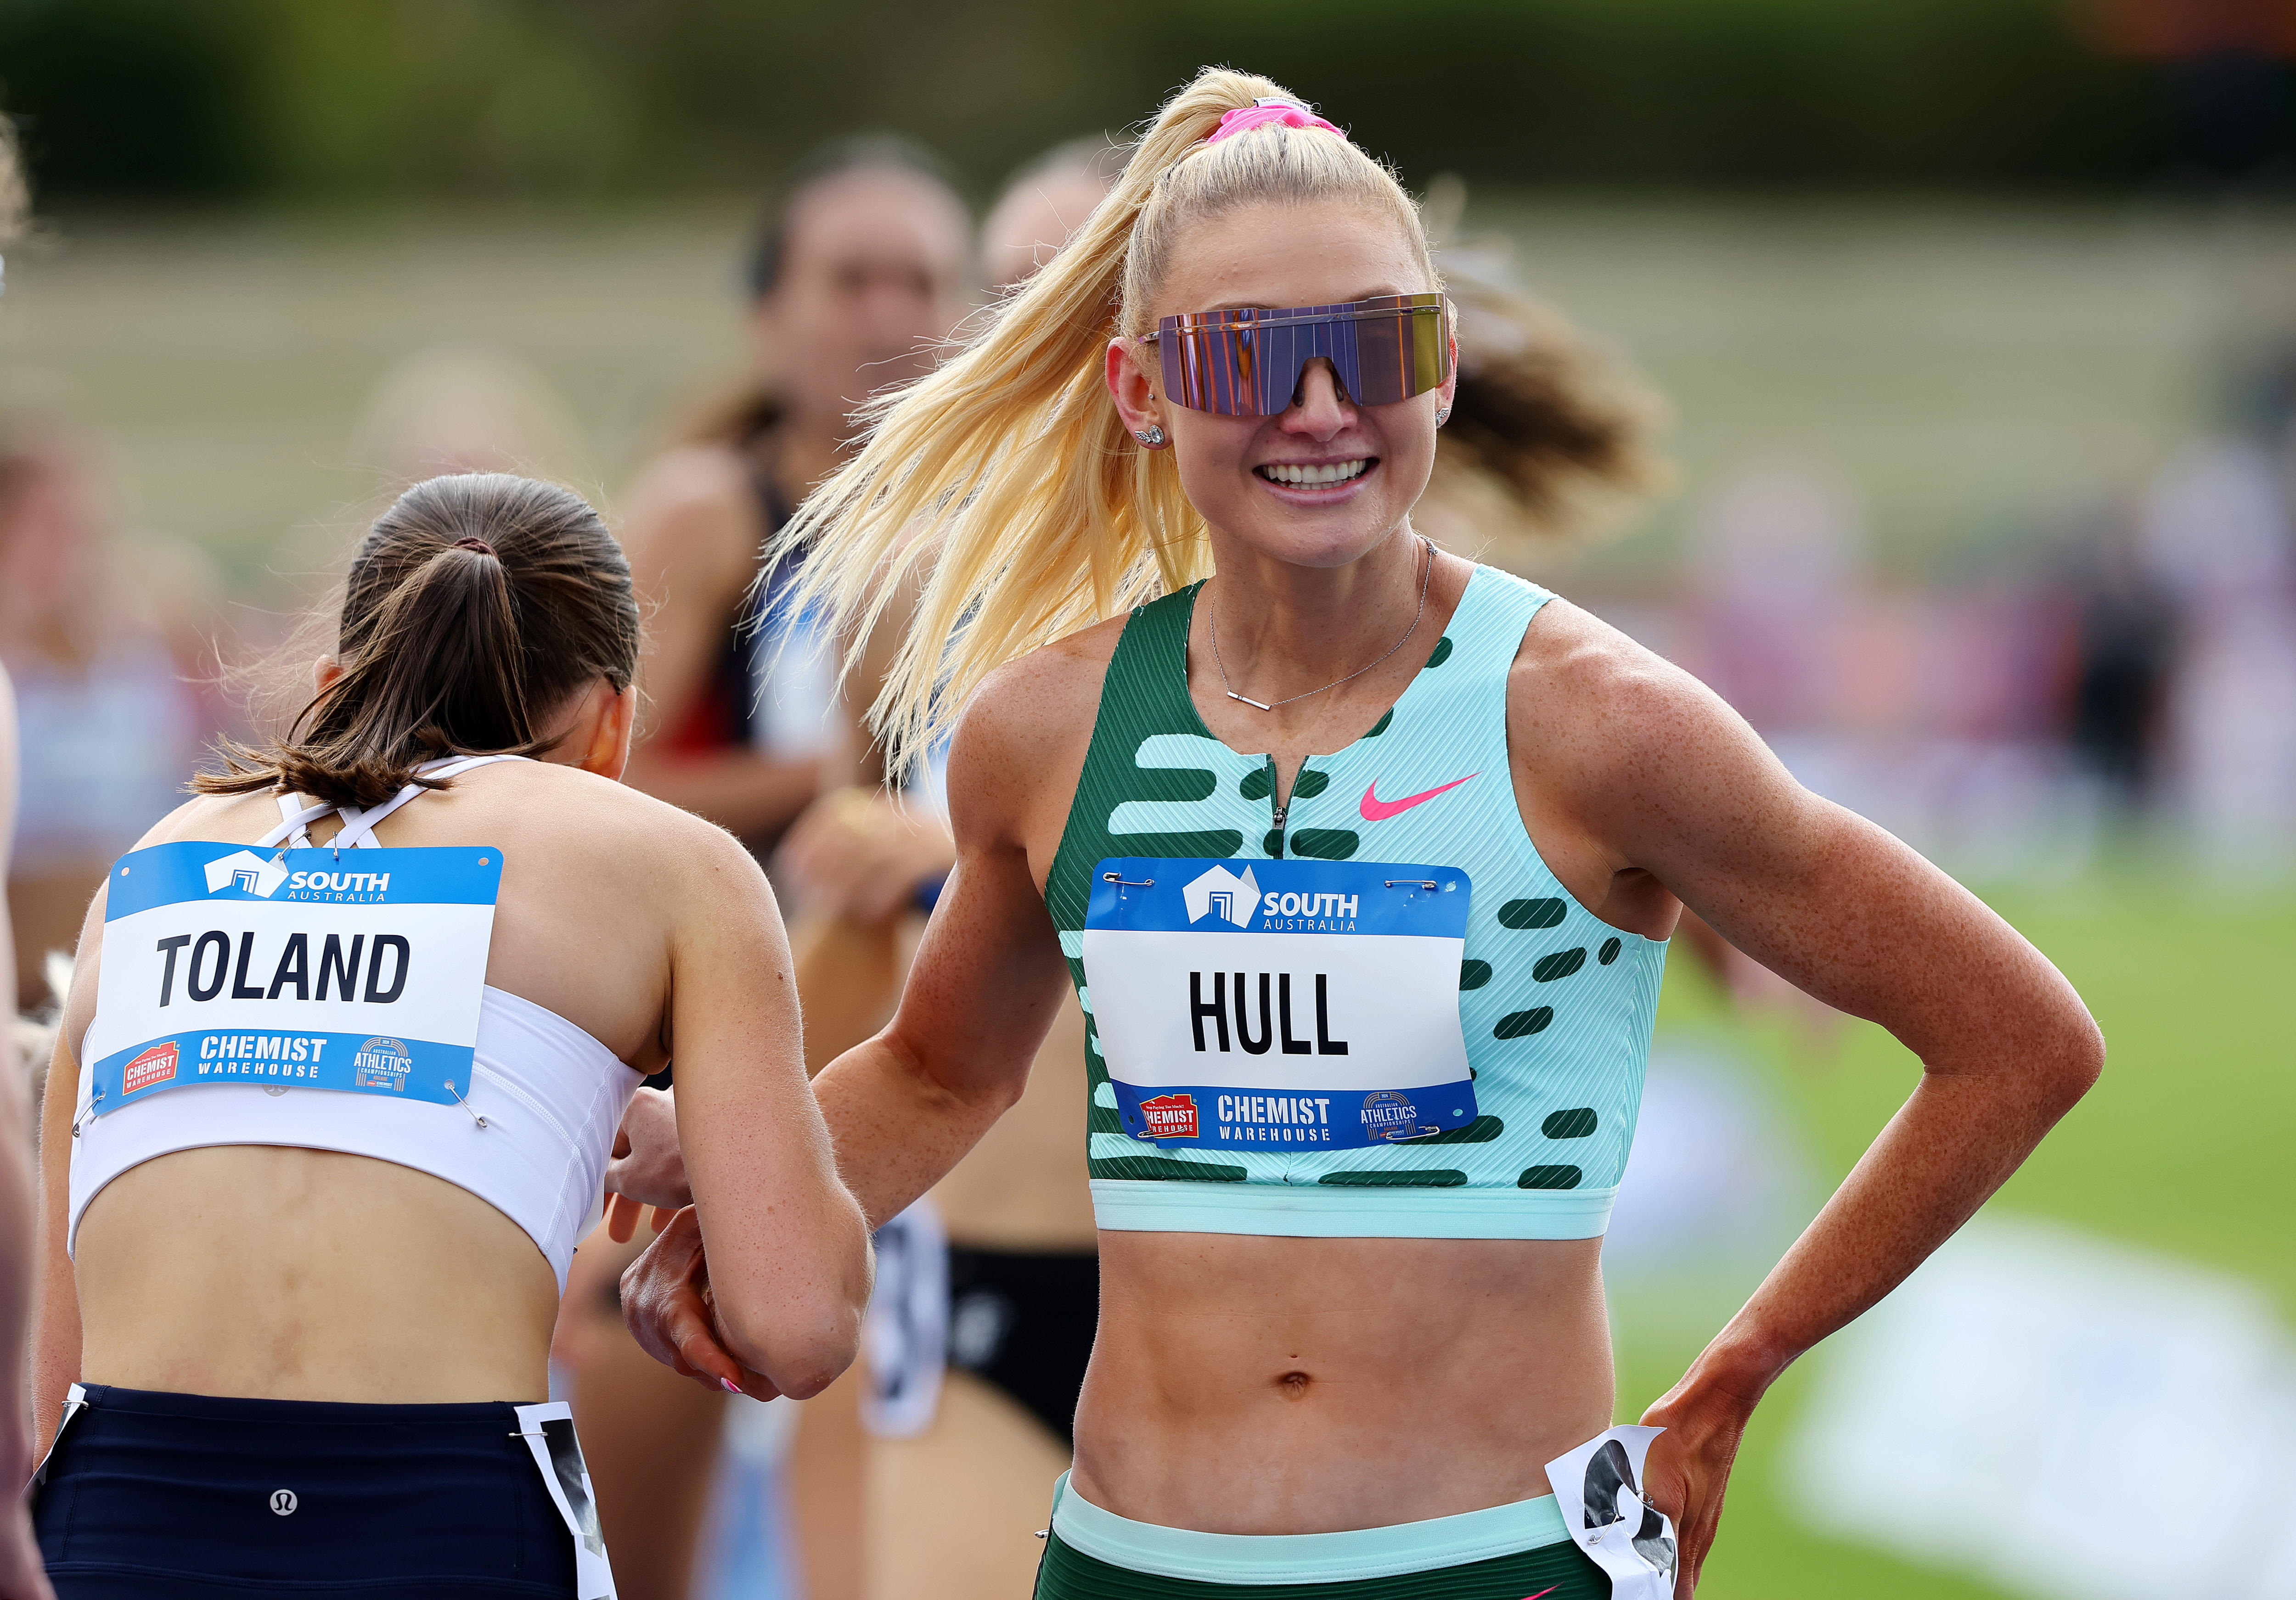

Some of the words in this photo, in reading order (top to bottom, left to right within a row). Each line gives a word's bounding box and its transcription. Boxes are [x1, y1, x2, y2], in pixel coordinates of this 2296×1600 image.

[289, 871, 390, 892] SOUTH
[287, 891, 385, 902] AUSTRALIA
[1263, 892, 1359, 918] SOUTH
[1263, 919, 1356, 932] AUSTRALIA
[157, 930, 410, 1007] TOLAND
[1189, 971, 1349, 1055] HULL
[200, 1035, 327, 1062] CHEMIST
[127, 1055, 175, 1081] CHEMIST
[198, 1061, 319, 1078] WAREHOUSE
[353, 1052, 412, 1073] ATHLETICS
[360, 1067, 403, 1078] CHAMPIONSHIPS
[126, 1068, 171, 1089] WAREHOUSE
[1143, 1109, 1194, 1124] HEMIST
[1218, 1095, 1330, 1124] CHEMIST
[1361, 1105, 1417, 1124] ATHLETICS
[1150, 1124, 1193, 1133] REHOUSE
[1370, 1119, 1411, 1128] CHAMPIONSHIPS
[1219, 1126, 1330, 1142] WAREHOUSE
